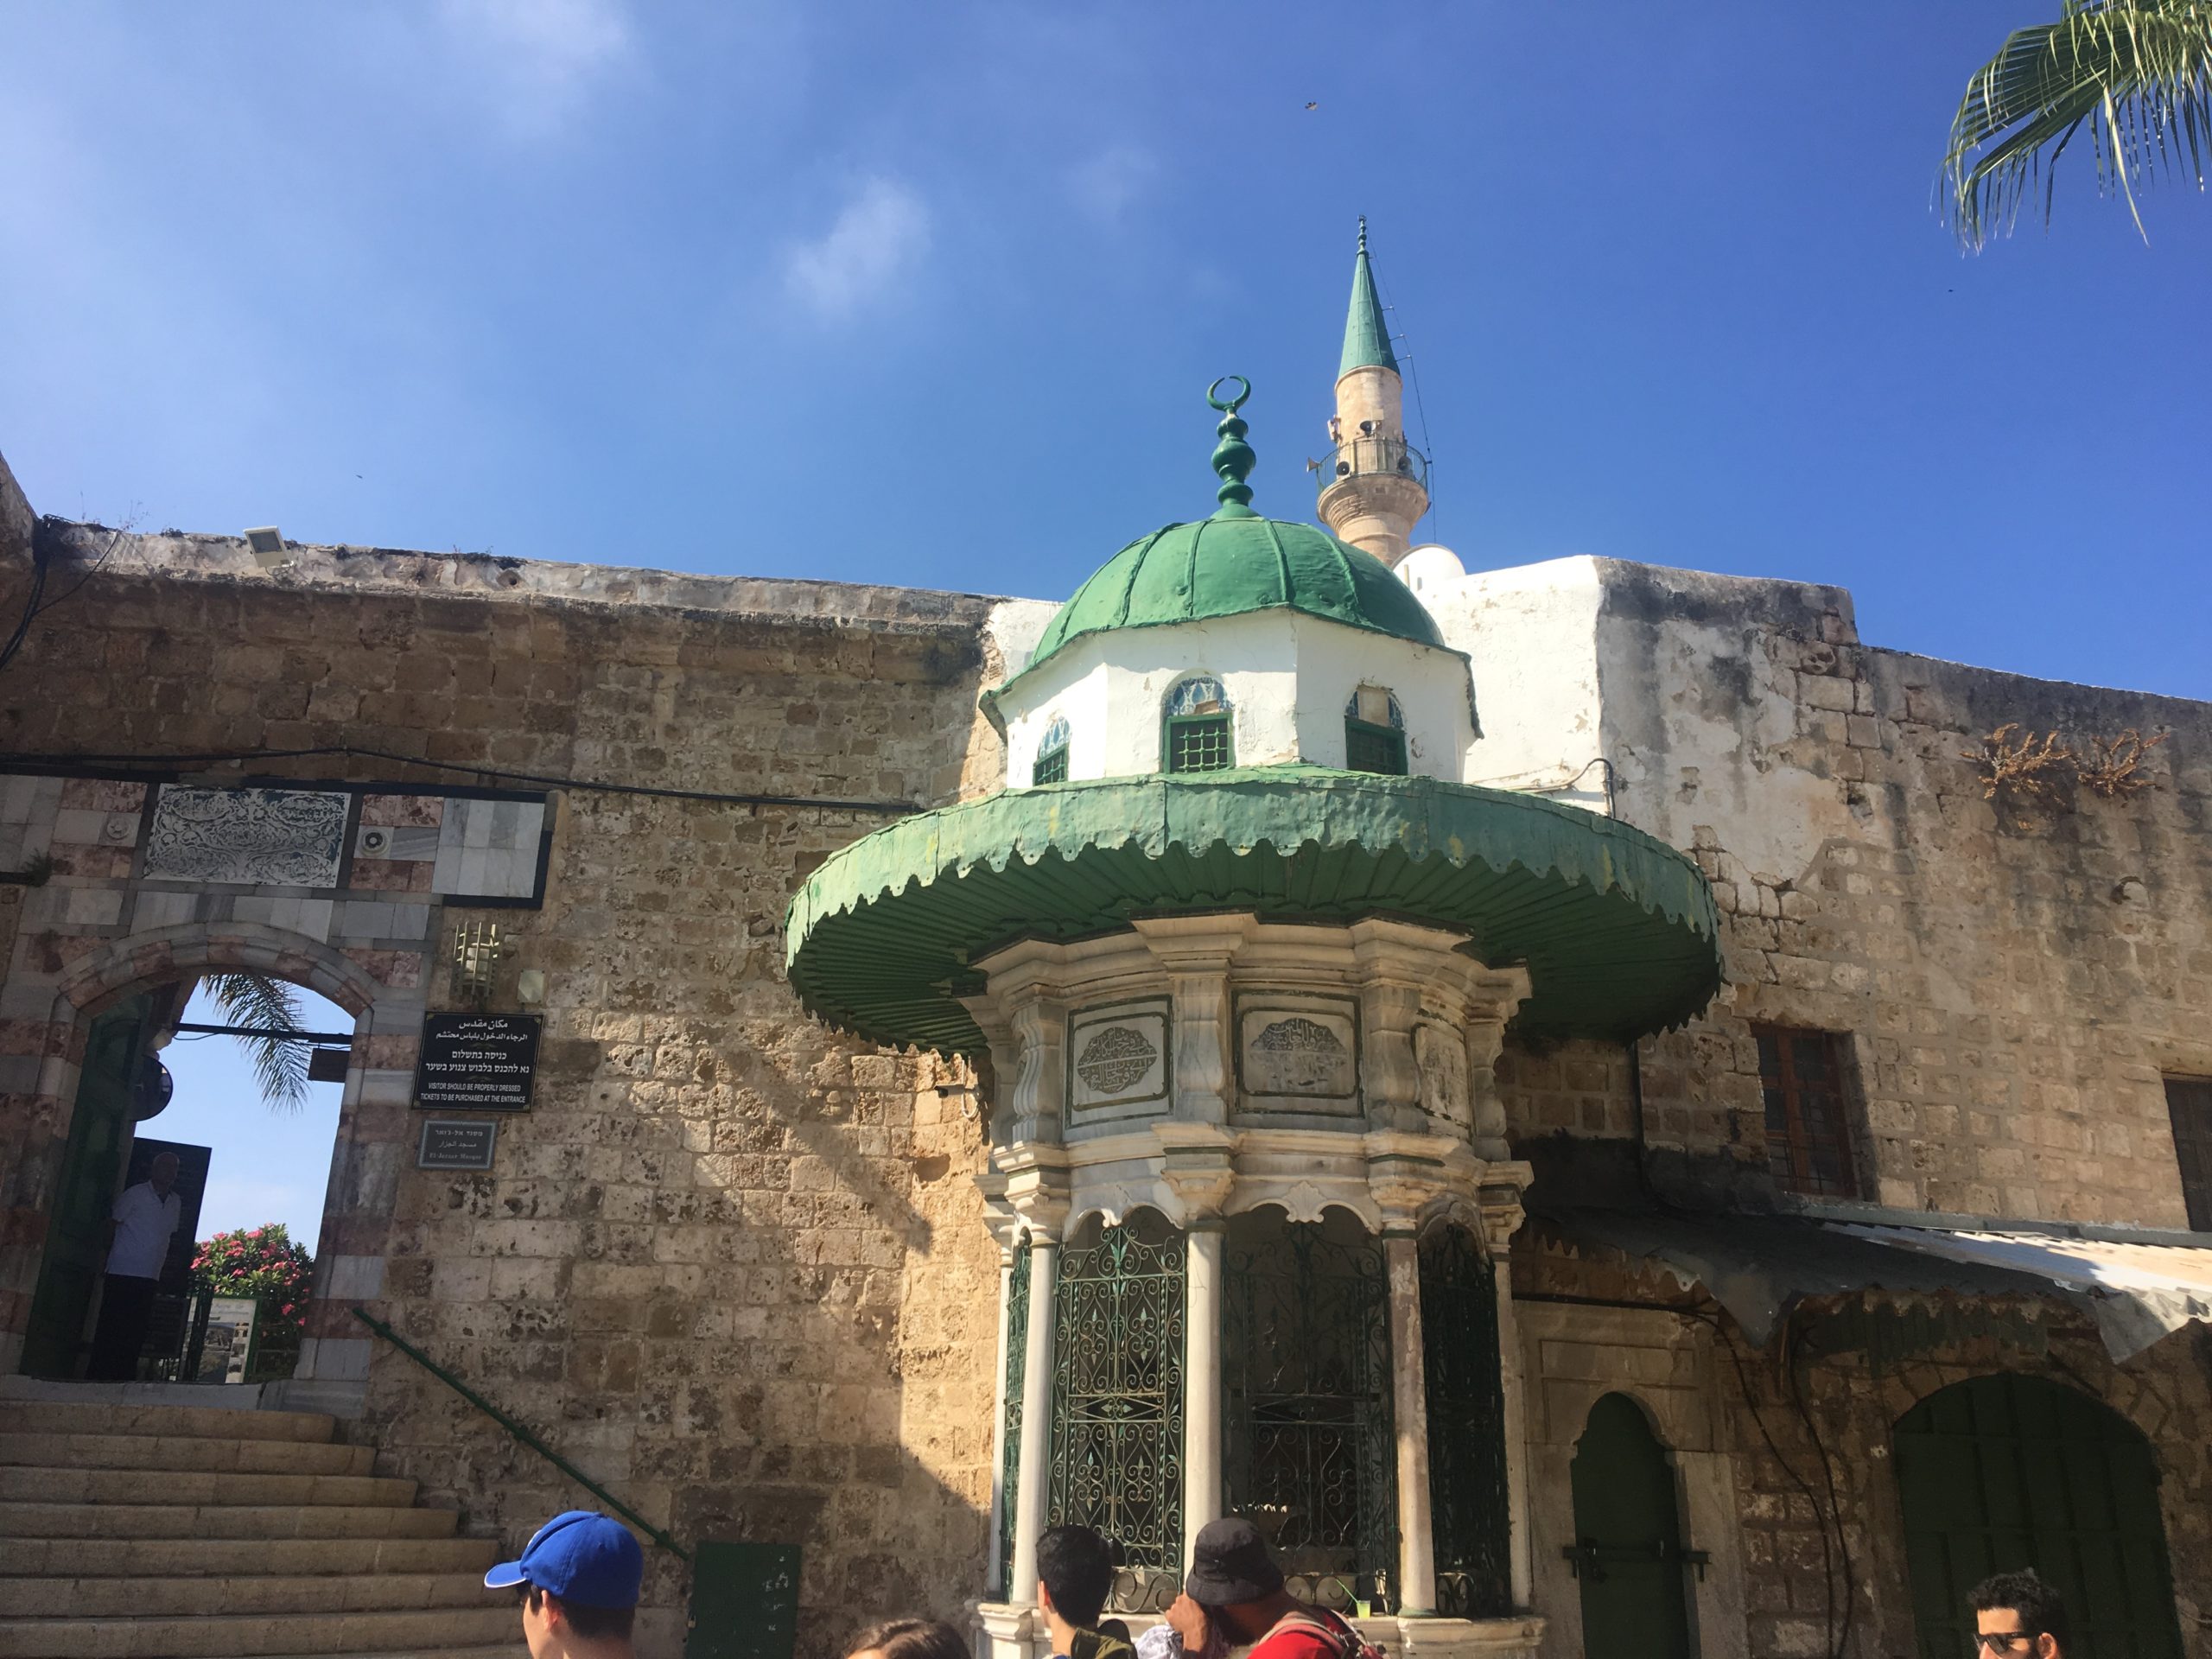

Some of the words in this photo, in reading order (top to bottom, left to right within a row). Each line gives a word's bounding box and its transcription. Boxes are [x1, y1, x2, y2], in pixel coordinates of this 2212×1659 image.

[459, 1020, 487, 1029] مقدس
[488, 1020, 508, 1030] مكان
[435, 1030, 459, 1039] محتشم
[460, 1032, 479, 1040] بلباس
[506, 1033, 527, 1042] الرجاء
[452, 1050, 482, 1058] בתשלום
[485, 1052, 506, 1060] כניסה
[468, 1063, 492, 1072] בלבוש
[494, 1064, 518, 1073] להכנס
